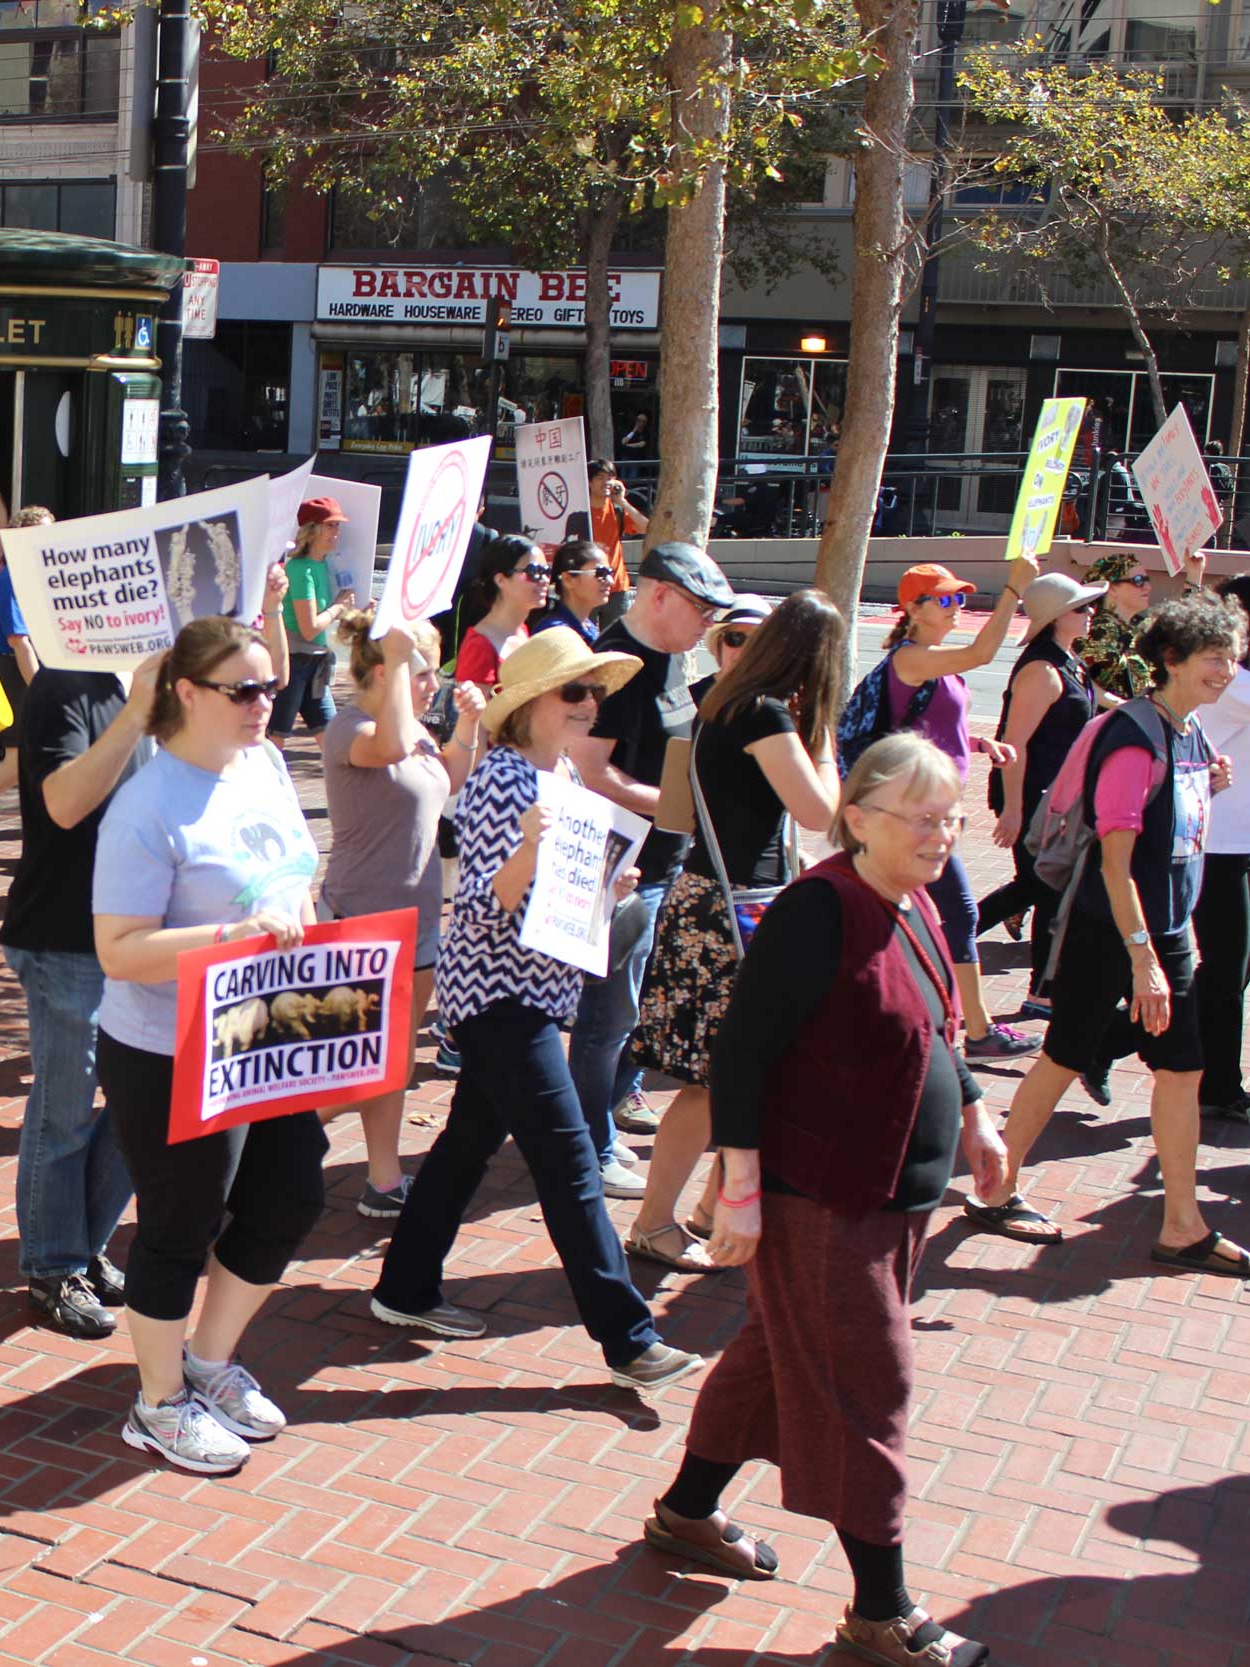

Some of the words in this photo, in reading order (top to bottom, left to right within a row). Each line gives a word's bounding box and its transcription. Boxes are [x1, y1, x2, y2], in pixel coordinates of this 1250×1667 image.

[189, 294, 205, 305] ANY
[353, 270, 520, 300] BARGAIN
[187, 308, 207, 321] TIME
[329, 303, 394, 317] HARDWARE
[404, 305, 481, 320] HOUSEWARE
[510, 308, 543, 321] EREO
[554, 309, 585, 322] GIFT
[611, 310, 644, 323] TOYS
[535, 426, 562, 451] 中国
[42, 548, 86, 567] How
[92, 536, 150, 560] many
[48, 559, 156, 591] elephants
[53, 589, 110, 611] must
[114, 579, 159, 604] die?
[58, 617, 82, 633] Say
[84, 614, 105, 629] NO
[105, 615, 122, 628] to
[123, 604, 166, 625] ivory!
[213, 952, 316, 1002] CARVING
[325, 948, 388, 981] INTO
[209, 1036, 382, 1098] EXTINCTION
[241, 1085, 266, 1098] ANIMAL
[268, 1079, 297, 1093] WELFARE
[299, 1076, 325, 1087] SOCIETY
